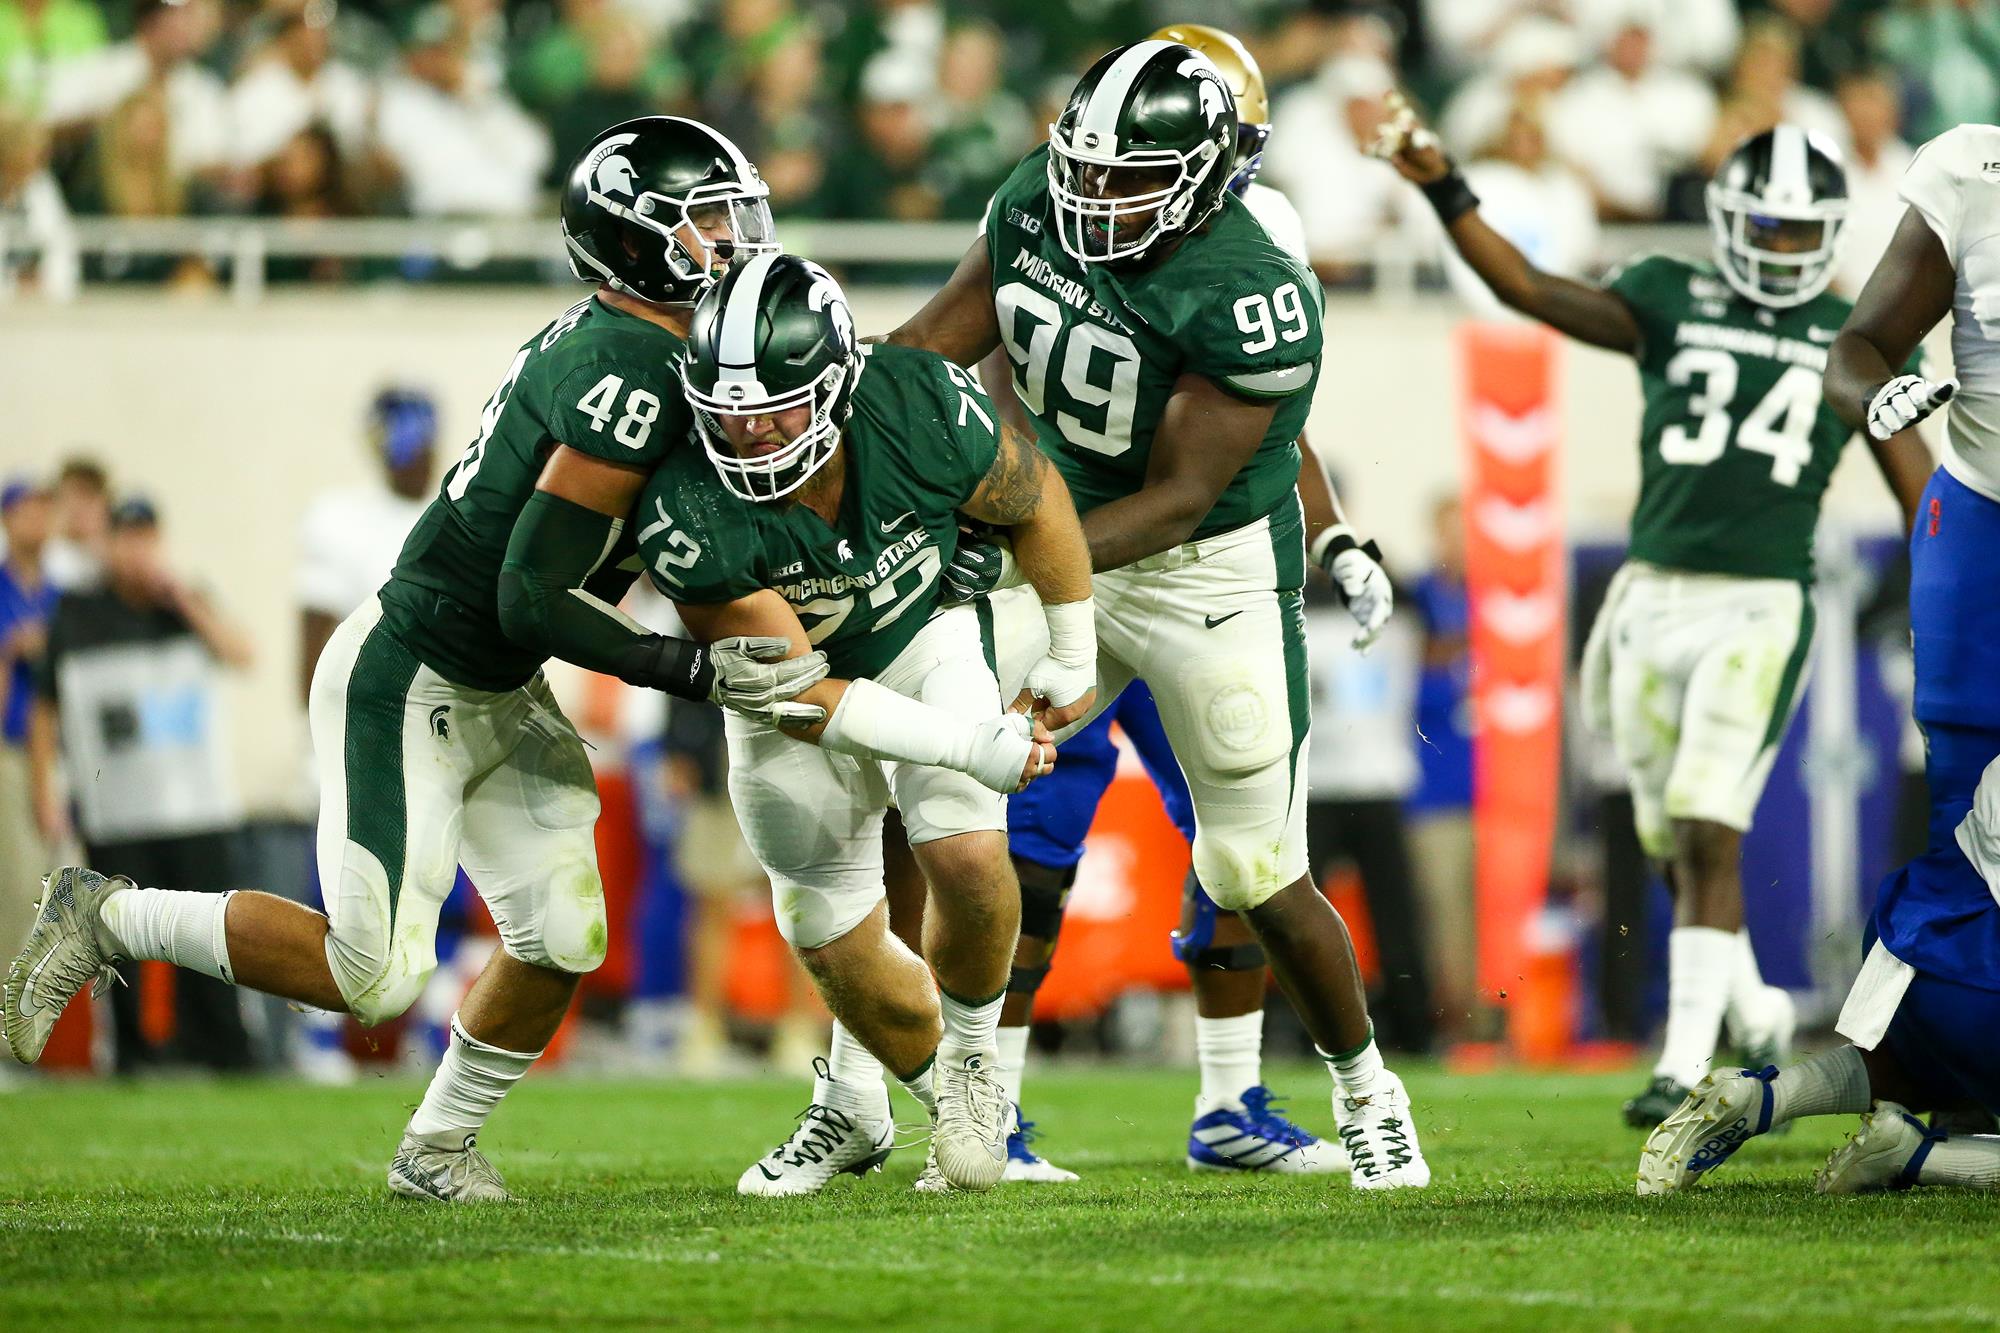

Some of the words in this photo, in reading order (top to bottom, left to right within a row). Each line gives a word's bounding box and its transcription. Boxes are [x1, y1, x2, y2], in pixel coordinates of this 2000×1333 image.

[1232, 282, 1309, 355] 99
[995, 281, 1142, 457] 99
[576, 373, 661, 450] 48
[1659, 348, 1824, 489] 34
[637, 495, 702, 589] 72
[772, 570, 877, 601] MICHIGAN
[876, 525, 931, 578] STATE
[1688, 1117, 1747, 1167] adida
